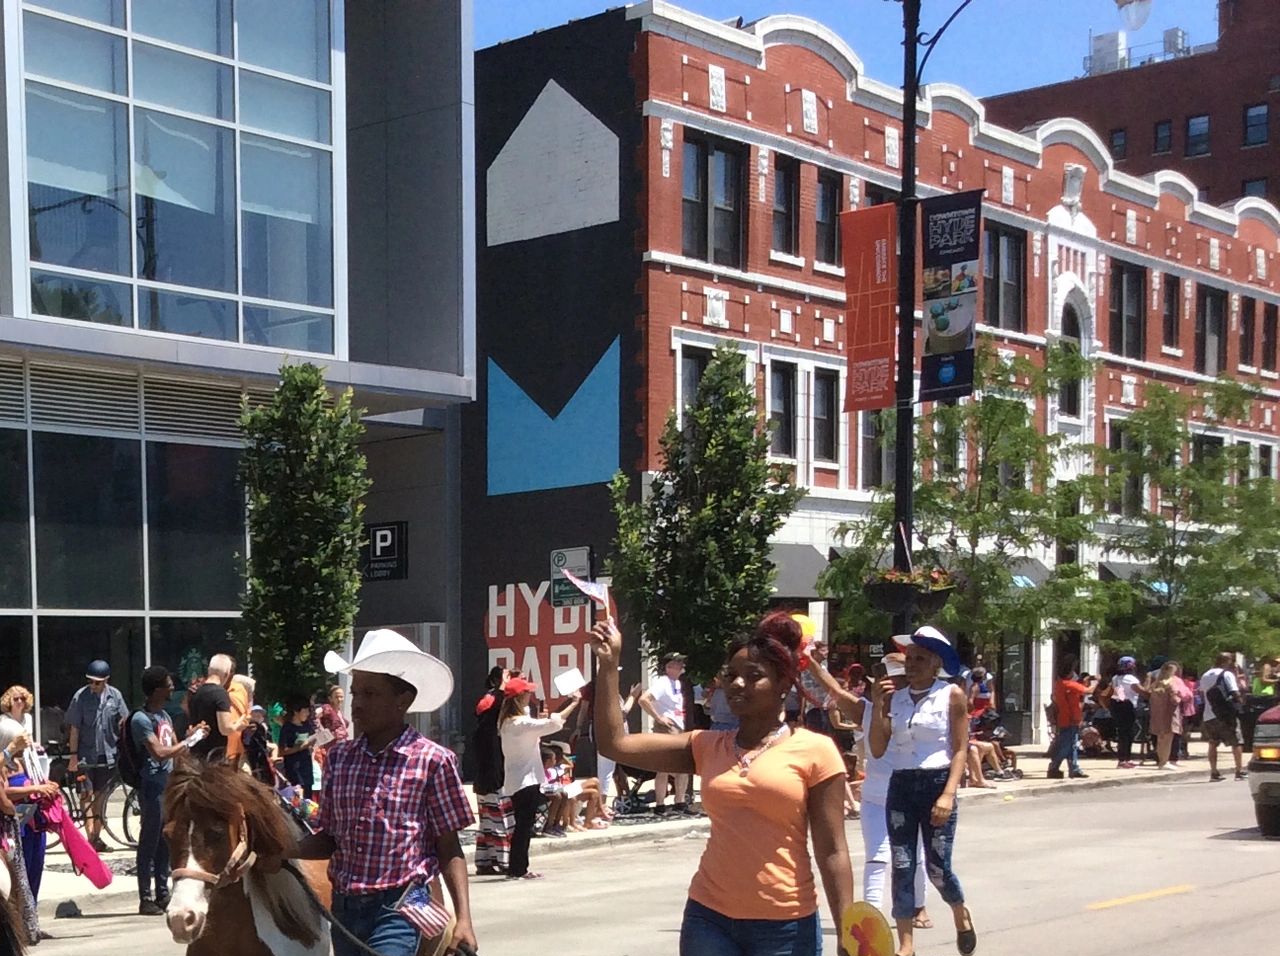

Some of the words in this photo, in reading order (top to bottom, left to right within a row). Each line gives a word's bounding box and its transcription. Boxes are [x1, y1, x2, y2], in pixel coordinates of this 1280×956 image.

[929, 214, 975, 235] HYDE
[929, 229, 975, 249] PARK
[852, 365, 889, 382] HYDE
[851, 378, 889, 395] PARK
[375, 530, 391, 556] P
